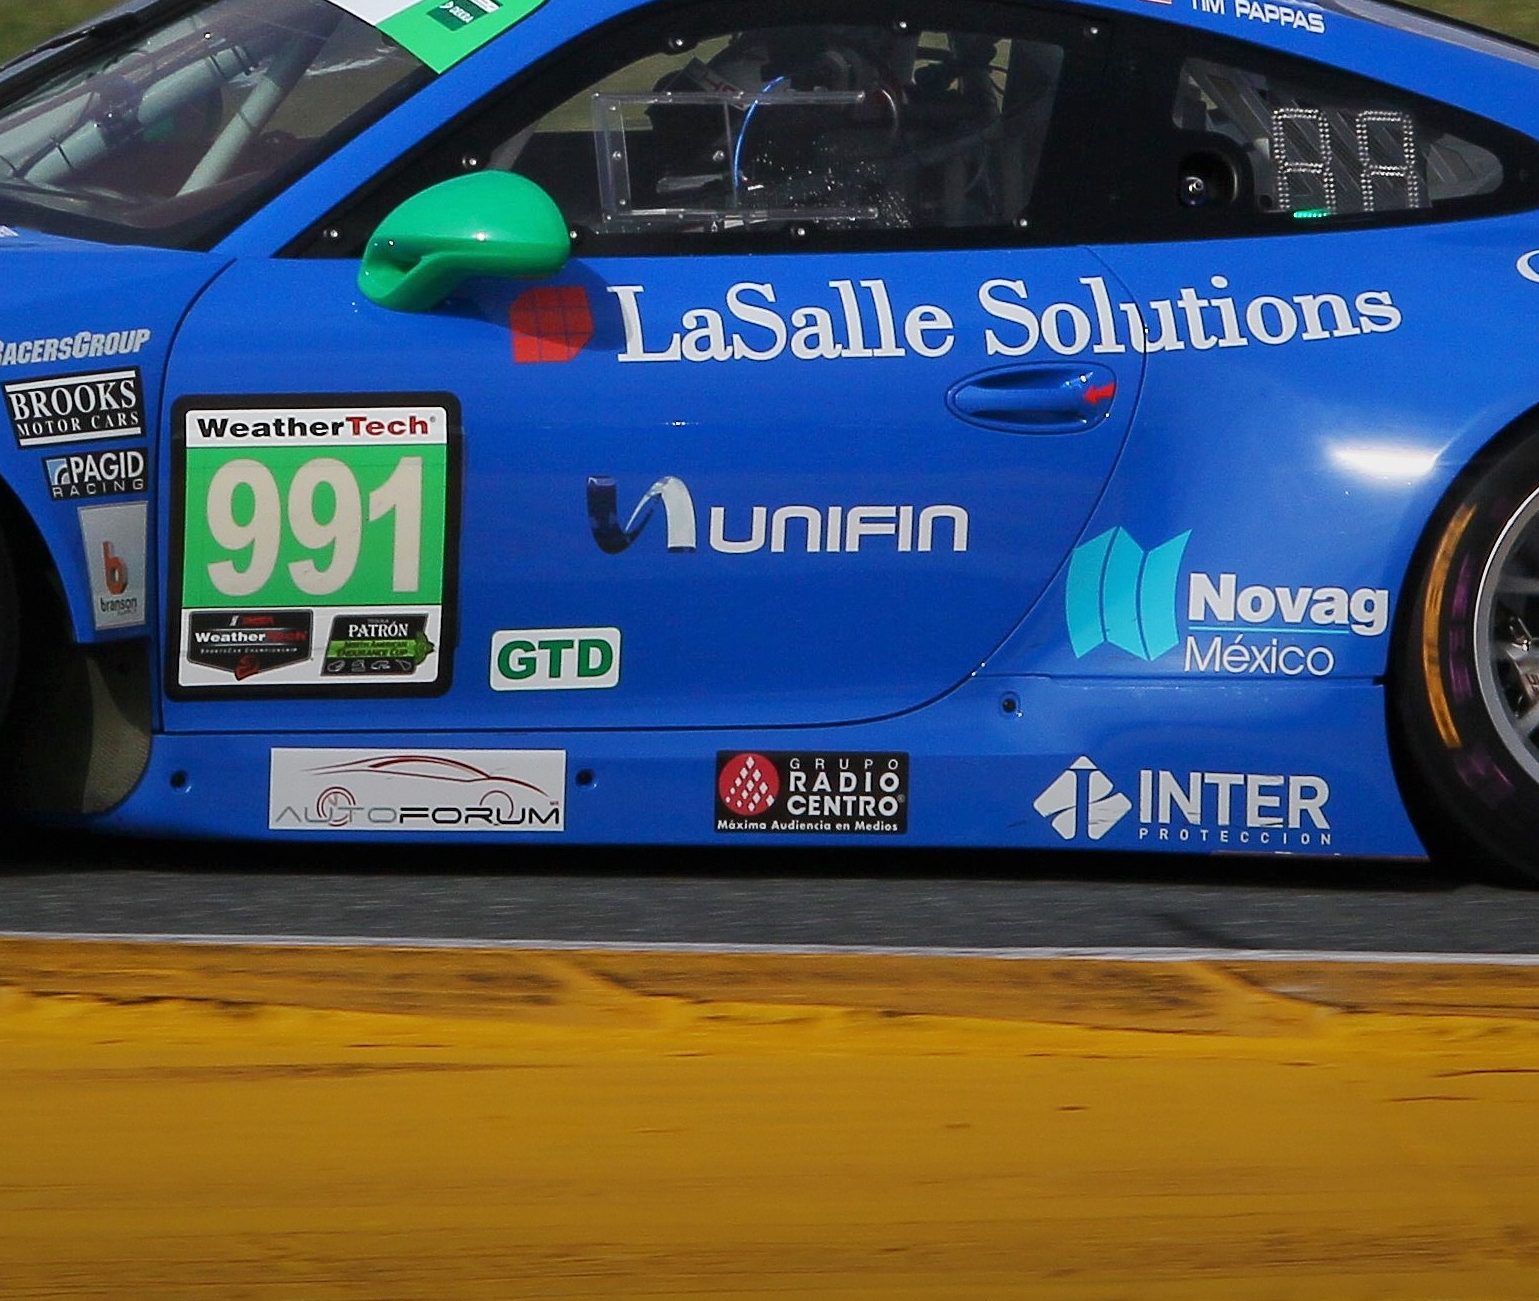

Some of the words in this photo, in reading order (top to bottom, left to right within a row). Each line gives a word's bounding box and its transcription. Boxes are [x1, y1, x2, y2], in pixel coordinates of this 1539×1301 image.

[606, 278, 956, 364] LaSalle
[977, 274, 1404, 358] Solutions
[8, 380, 137, 421] BROOKS
[16, 417, 82, 437] MOTOR
[91, 411, 140, 430] CARS
[197, 415, 429, 438] WeatherTech
[70, 451, 144, 483] PAGID
[52, 478, 145, 499] RACING
[207, 456, 423, 597] 991
[1187, 572, 1390, 637] Novag
[348, 621, 409, 638] PATRÓN
[497, 639, 614, 680] GTD
[1184, 633, 1335, 676] México
[790, 758, 899, 770] GRUPO
[789, 771, 900, 792] RADIO
[787, 795, 898, 816] CENTRO
[1139, 769, 1331, 829] INTER
[275, 805, 559, 824] AUTOFORUM
[717, 819, 767, 830] Máxima
[771, 820, 831, 831] Audiencia
[836, 822, 850, 831] en
[855, 821, 898, 832] Medios
[1139, 828, 1332, 845] PROTECCION
